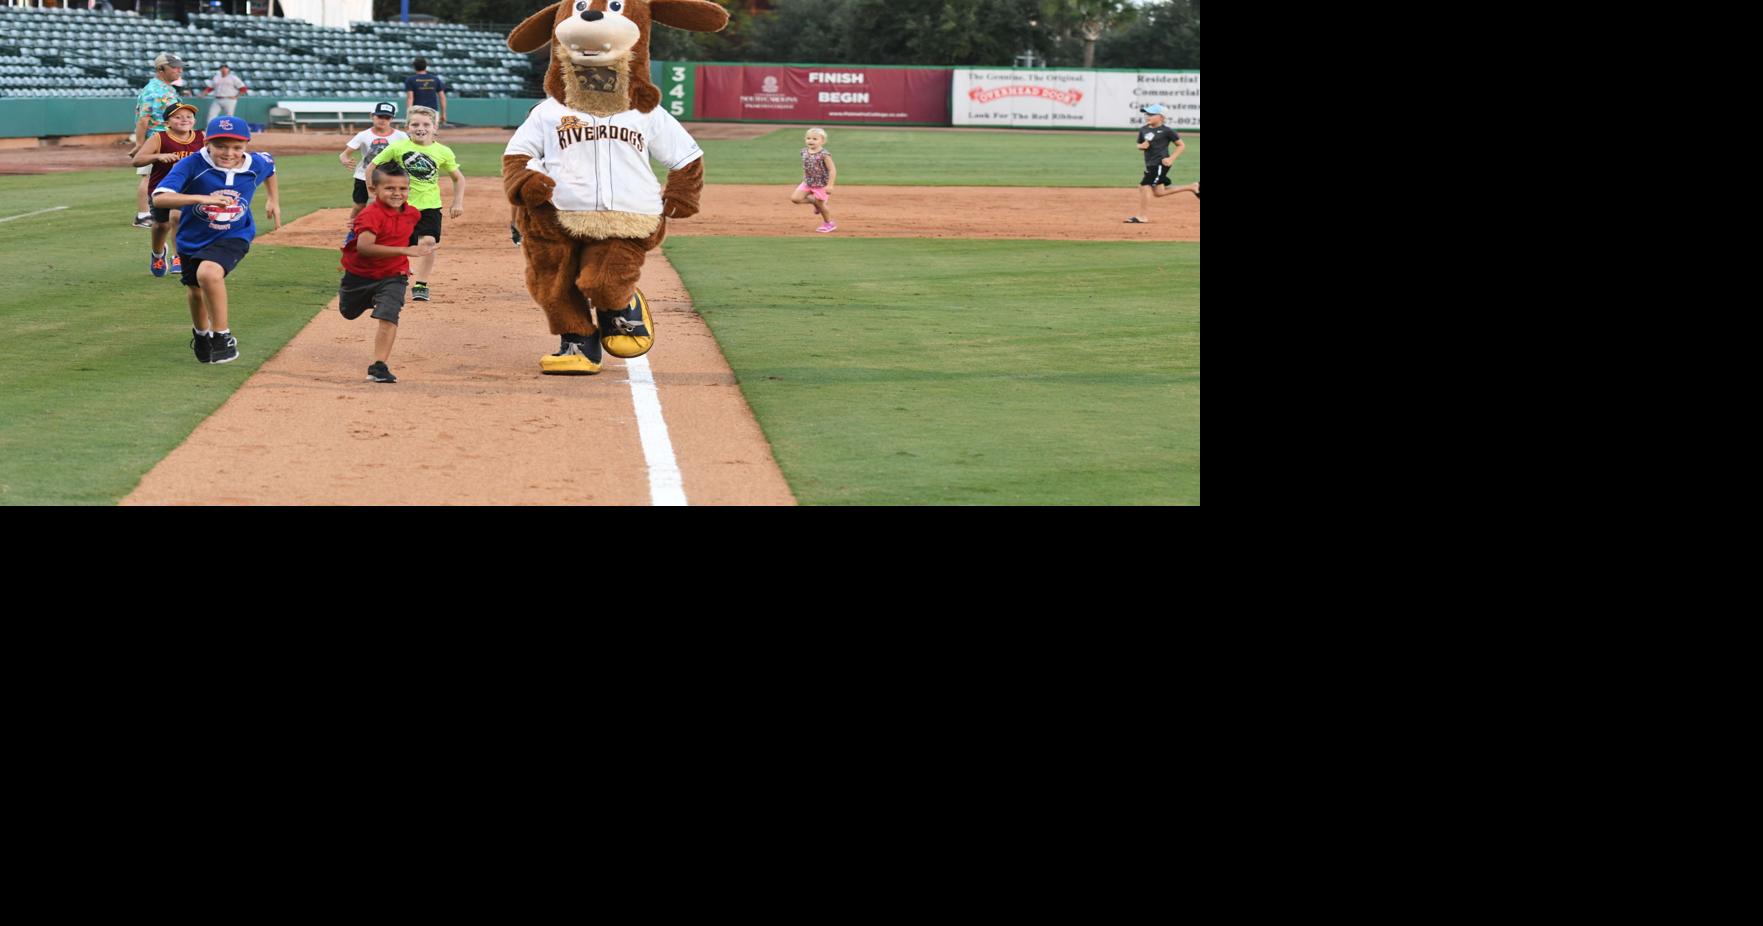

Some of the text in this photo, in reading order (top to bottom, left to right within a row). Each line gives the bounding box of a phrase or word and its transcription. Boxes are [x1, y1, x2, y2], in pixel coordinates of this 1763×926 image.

[808, 72, 864, 84] FINISH
[968, 73, 985, 81] The
[1136, 75, 1198, 83] Residential
[818, 91, 870, 103] BEGIN
[979, 86, 1073, 105] OVERHEAD DOOR
[1132, 88, 1200, 96] Commercial
[557, 124, 645, 153] RIVERDOGS
